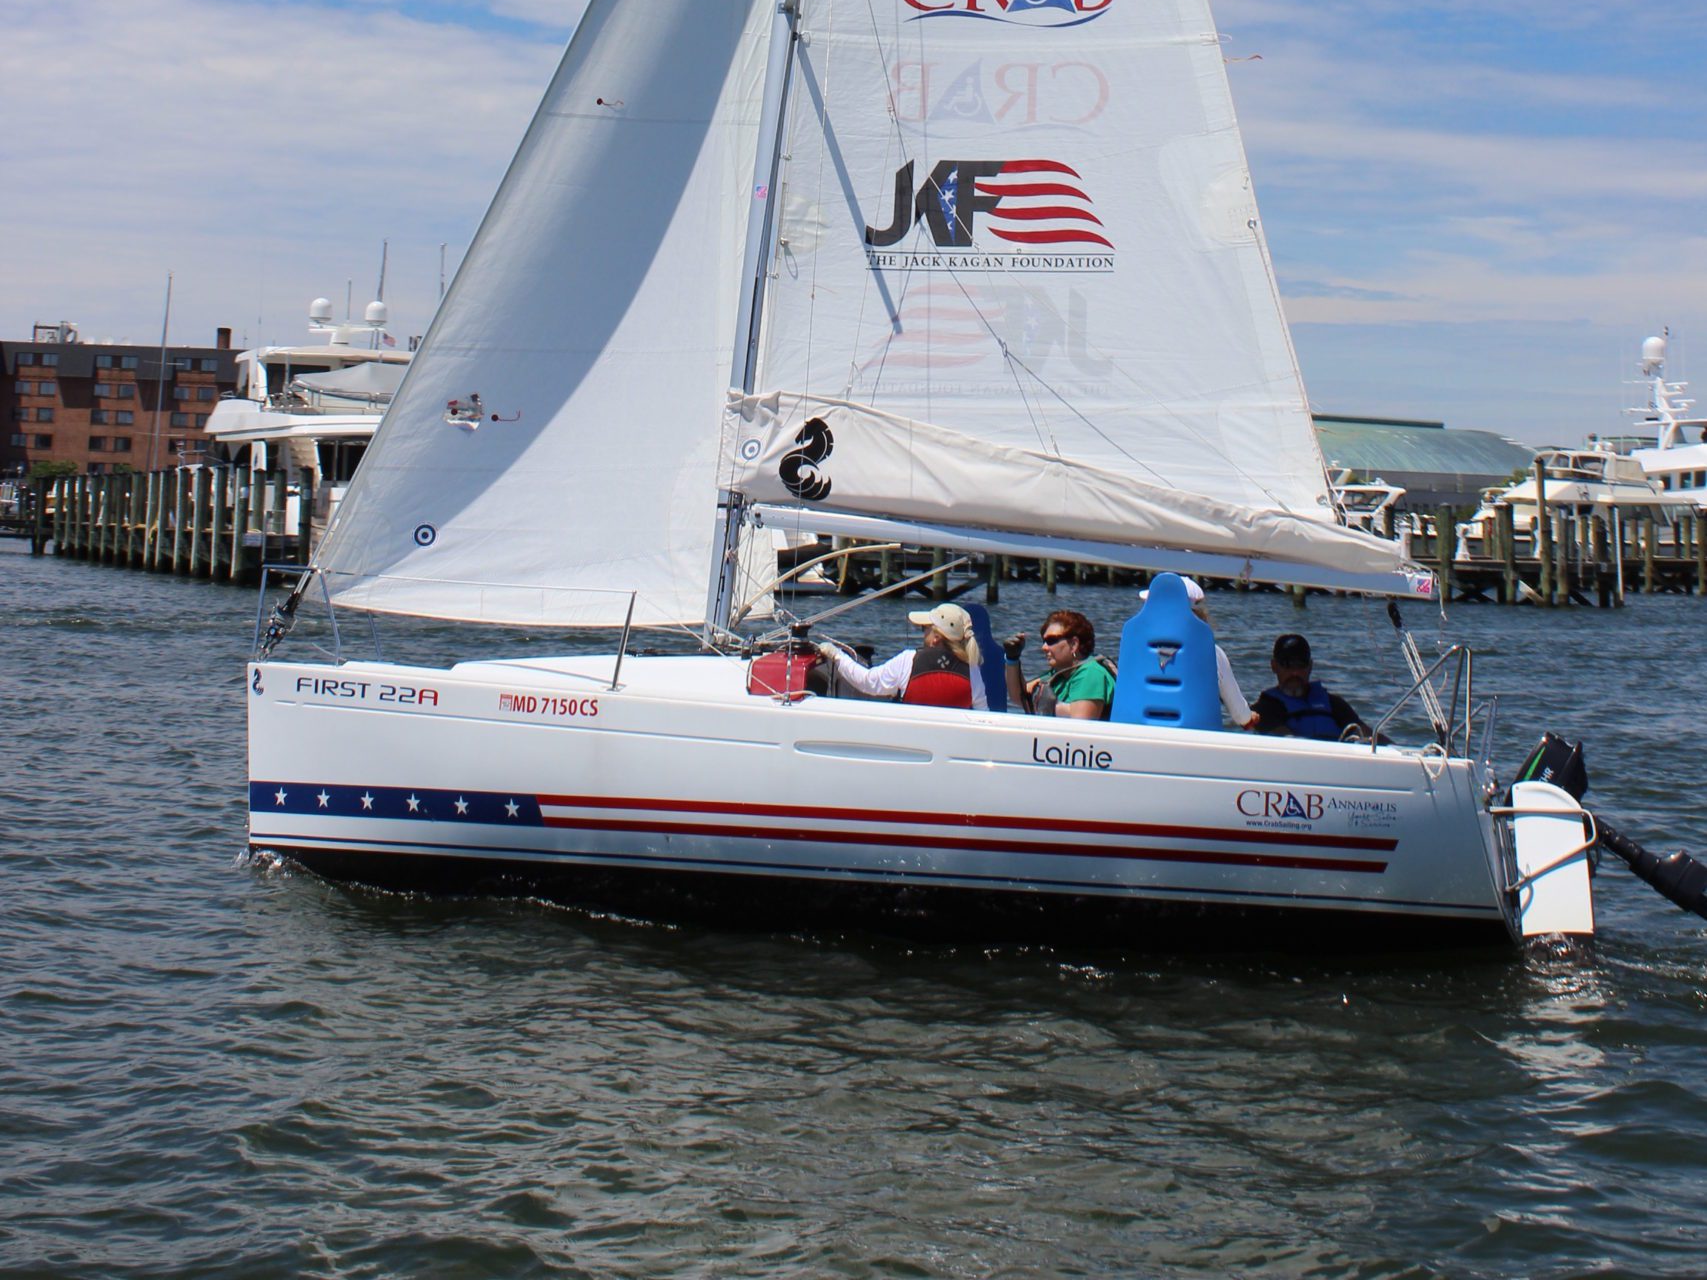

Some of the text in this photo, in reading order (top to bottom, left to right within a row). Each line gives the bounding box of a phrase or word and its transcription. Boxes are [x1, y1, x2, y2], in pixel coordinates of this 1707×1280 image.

[866, 256, 1114, 269] THE JACK KAGAN FOUNDATION
[296, 677, 439, 706] FIRST 22A
[512, 694, 537, 713] MD
[1032, 737, 1113, 769] Lainie
[1236, 790, 1324, 821] CRAB
[1327, 797, 1397, 813] ANNAPOLIS
